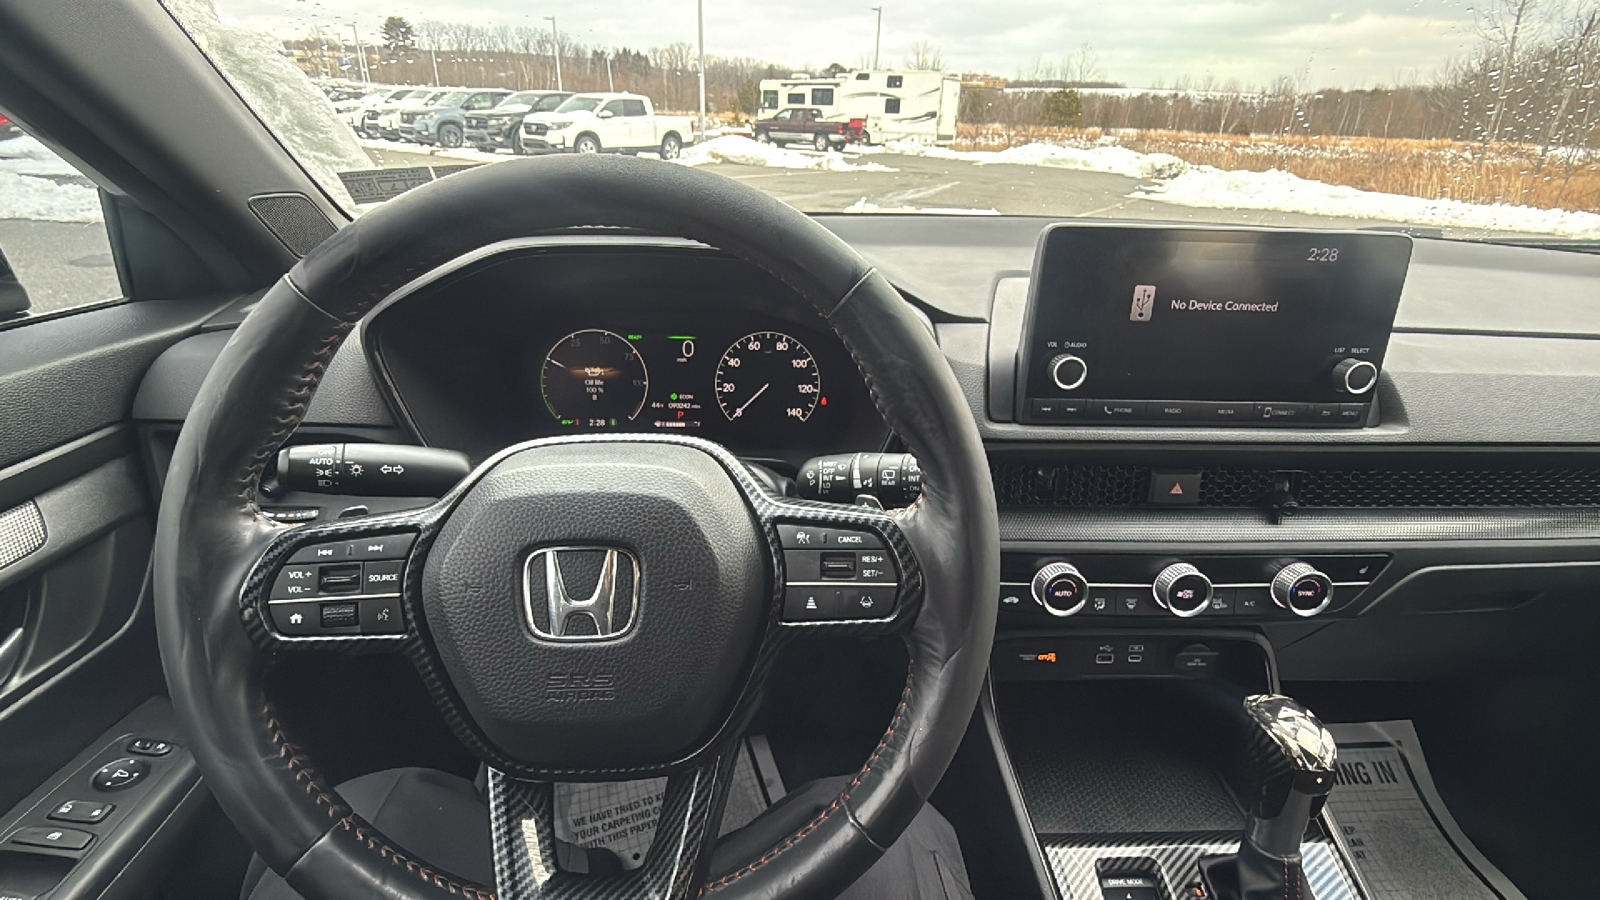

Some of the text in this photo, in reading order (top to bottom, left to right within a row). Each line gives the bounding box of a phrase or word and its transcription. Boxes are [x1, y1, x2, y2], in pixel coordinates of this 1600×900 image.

[1307, 248, 1339, 261] 2:28
[1170, 300, 1279, 312] No Device Connected
[571, 338, 580, 347] 25
[600, 337, 610, 345] 50
[682, 340, 694, 358] 0
[748, 341, 760, 351] 60
[776, 342, 788, 351] 80
[624, 352, 634, 361] 75
[728, 358, 740, 367] 40
[792, 359, 808, 368] 100
[723, 383, 735, 392] 20
[798, 384, 813, 393] 120
[677, 411, 684, 419] P
[786, 408, 802, 417] 140
[309, 457, 333, 465] AUTO
[837, 535, 863, 544] CANCEL
[368, 574, 399, 582] SOURCE
[545, 674, 615, 688] SRS
[545, 690, 616, 703] AIRBAG
[1332, 761, 1398, 786] ING IN
[572, 816, 586, 827] WE
[590, 809, 613, 823] HAVE
[615, 801, 641, 815] TRIED
[642, 796, 654, 806] TO
[574, 826, 600, 840] YOUR
[601, 809, 651, 833] CARPETING
[607, 828, 629, 842] THIS
[1107, 878, 1126, 886] DRIVE
